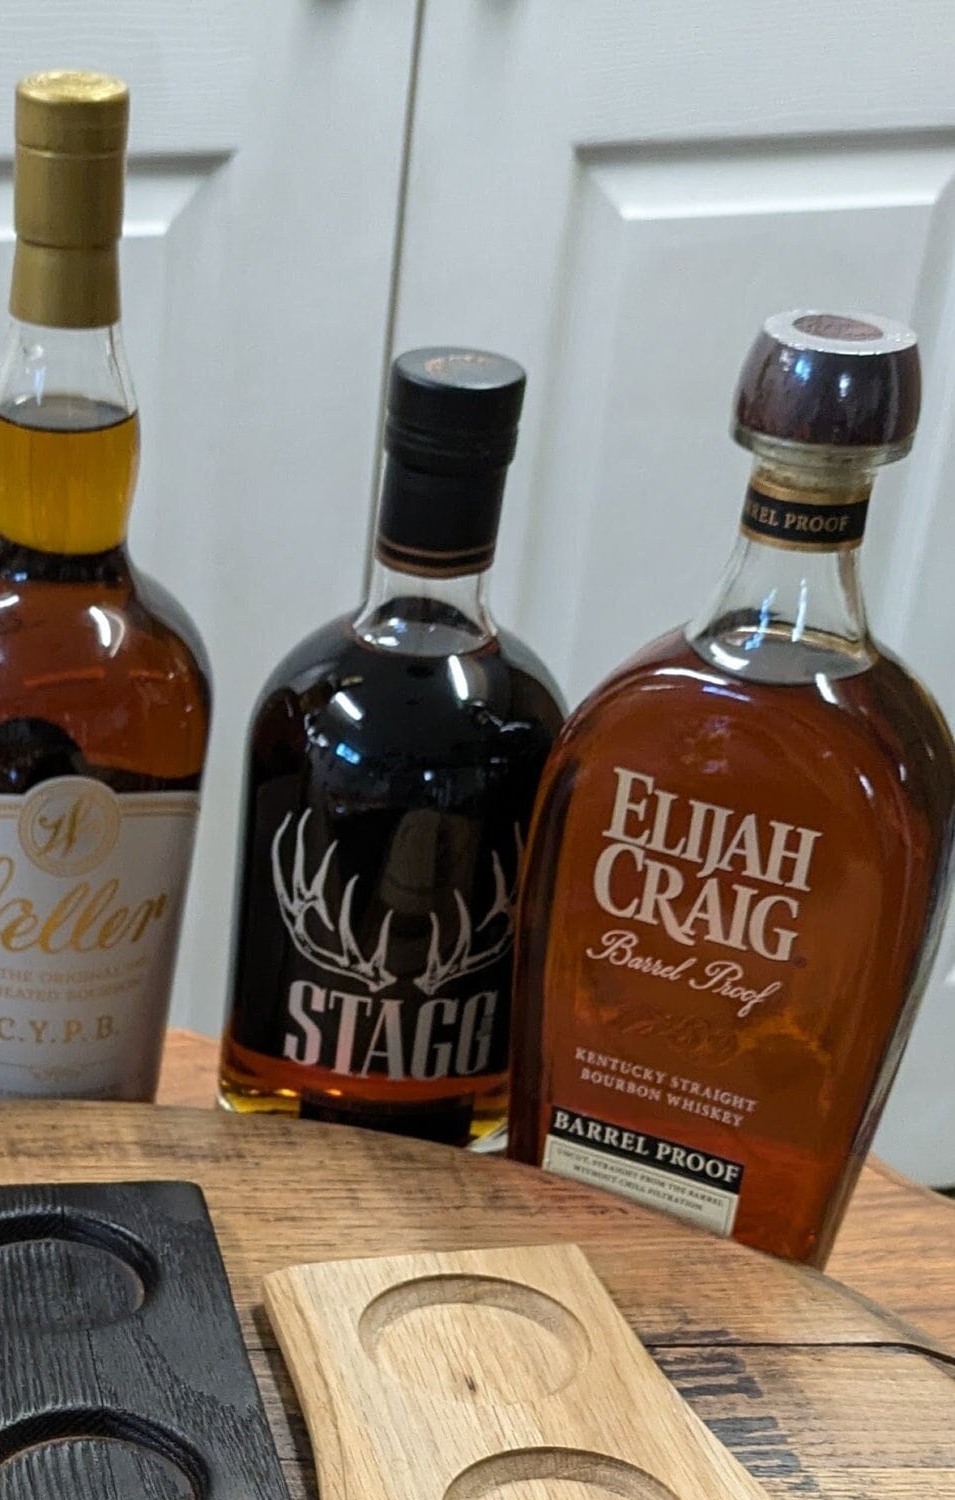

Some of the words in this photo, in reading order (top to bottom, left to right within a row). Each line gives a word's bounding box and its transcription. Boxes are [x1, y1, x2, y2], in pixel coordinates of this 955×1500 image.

[784, 512, 851, 533] PROOF
[601, 766, 823, 892] ELIJAH
[593, 842, 799, 962] CRAIG
[586, 928, 697, 982] Barrel
[688, 960, 783, 1018] Proof
[283, 979, 499, 1082] STAGG
[574, 1046, 667, 1085] KENTUCKY
[670, 1074, 759, 1113] STRAIGHT
[580, 1067, 661, 1101] BOURBON
[666, 1092, 745, 1128] WHISKEY
[552, 1110, 650, 1156] BARREL
[655, 1141, 741, 1184] PROOF
